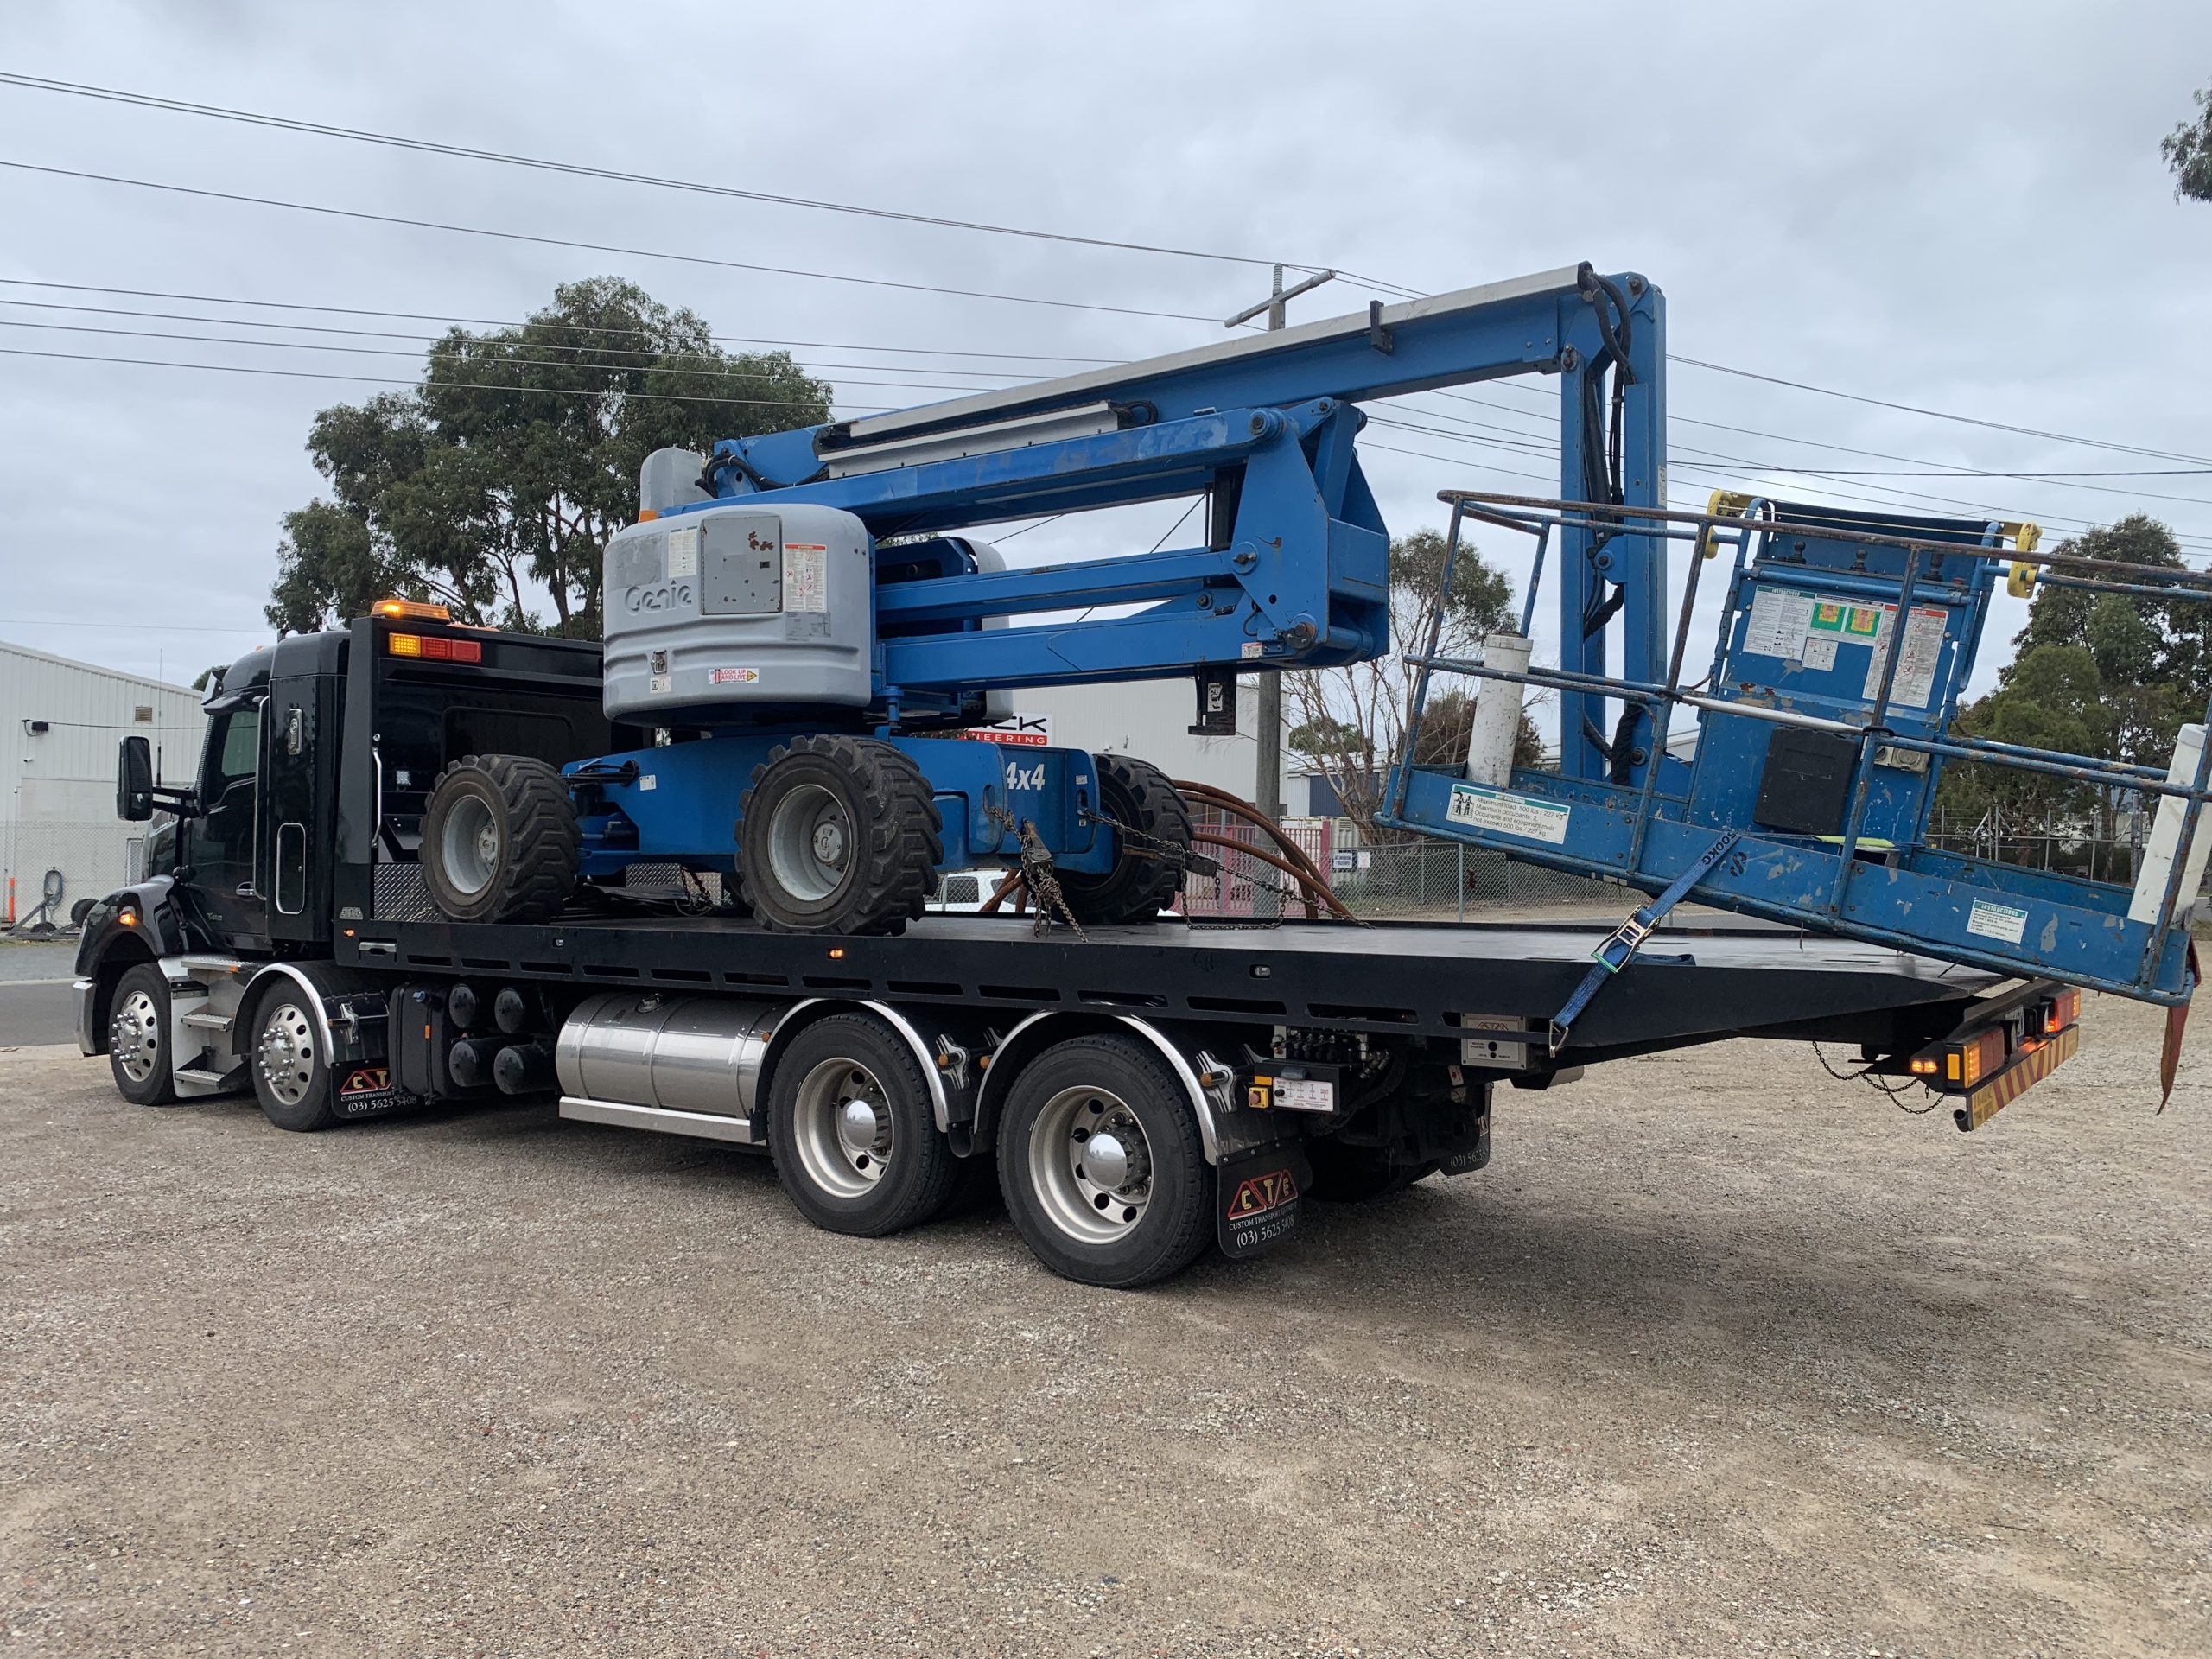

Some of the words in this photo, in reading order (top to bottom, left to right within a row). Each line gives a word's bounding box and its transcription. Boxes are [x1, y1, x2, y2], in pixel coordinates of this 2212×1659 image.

[625, 579, 692, 615] Genie
[1006, 761, 1046, 791] 4x4
[1476, 804, 1501, 814] Maximum
[1478, 798, 1503, 807] Maximum
[348, 1102, 368, 1113] (03)
[370, 1098, 394, 1109] 5625
[1229, 1218, 1255, 1231] CUSTOM
[1236, 1229, 1258, 1249] (03)
[1261, 1221, 1281, 1241] 5625
